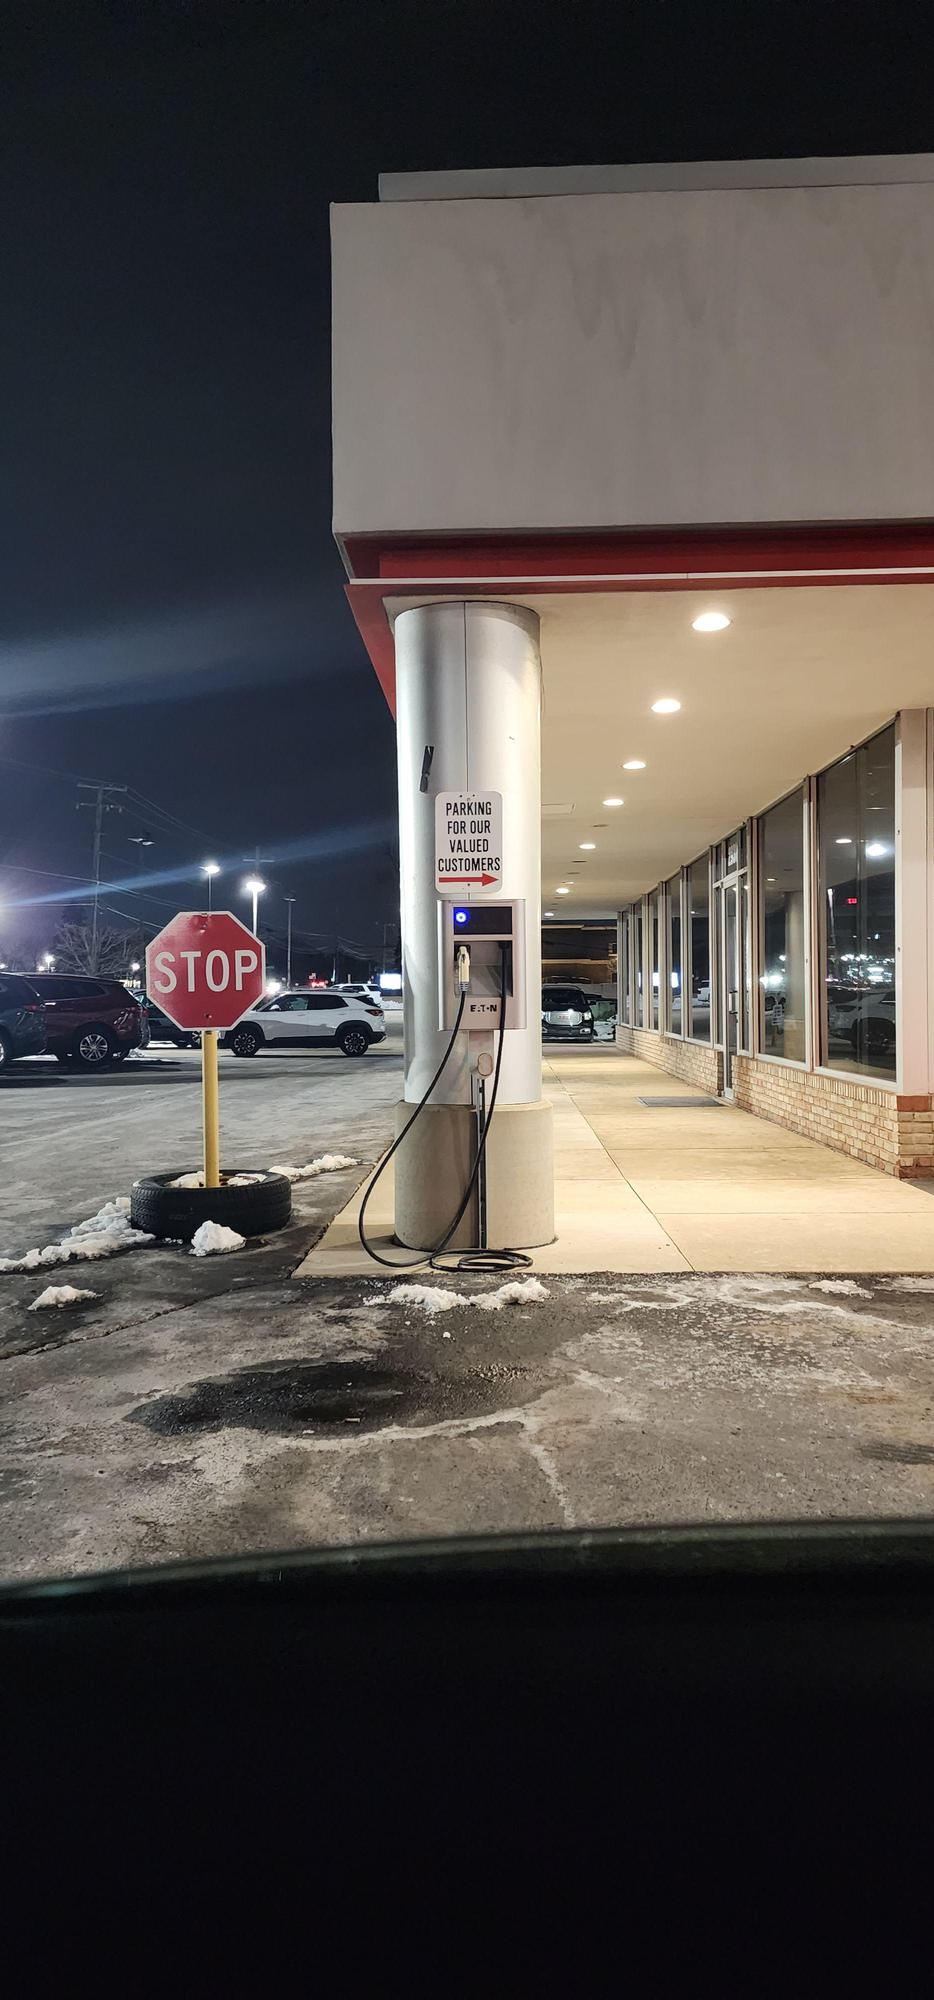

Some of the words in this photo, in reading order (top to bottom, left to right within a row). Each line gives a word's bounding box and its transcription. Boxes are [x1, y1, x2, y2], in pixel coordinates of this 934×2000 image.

[446, 801, 492, 816] PARKING
[447, 820, 467, 834] FOR
[470, 820, 491, 834] OUR
[449, 839, 489, 853] VALUED
[438, 857, 501, 872] CUSTOMERS
[154, 949, 258, 994] STOP
